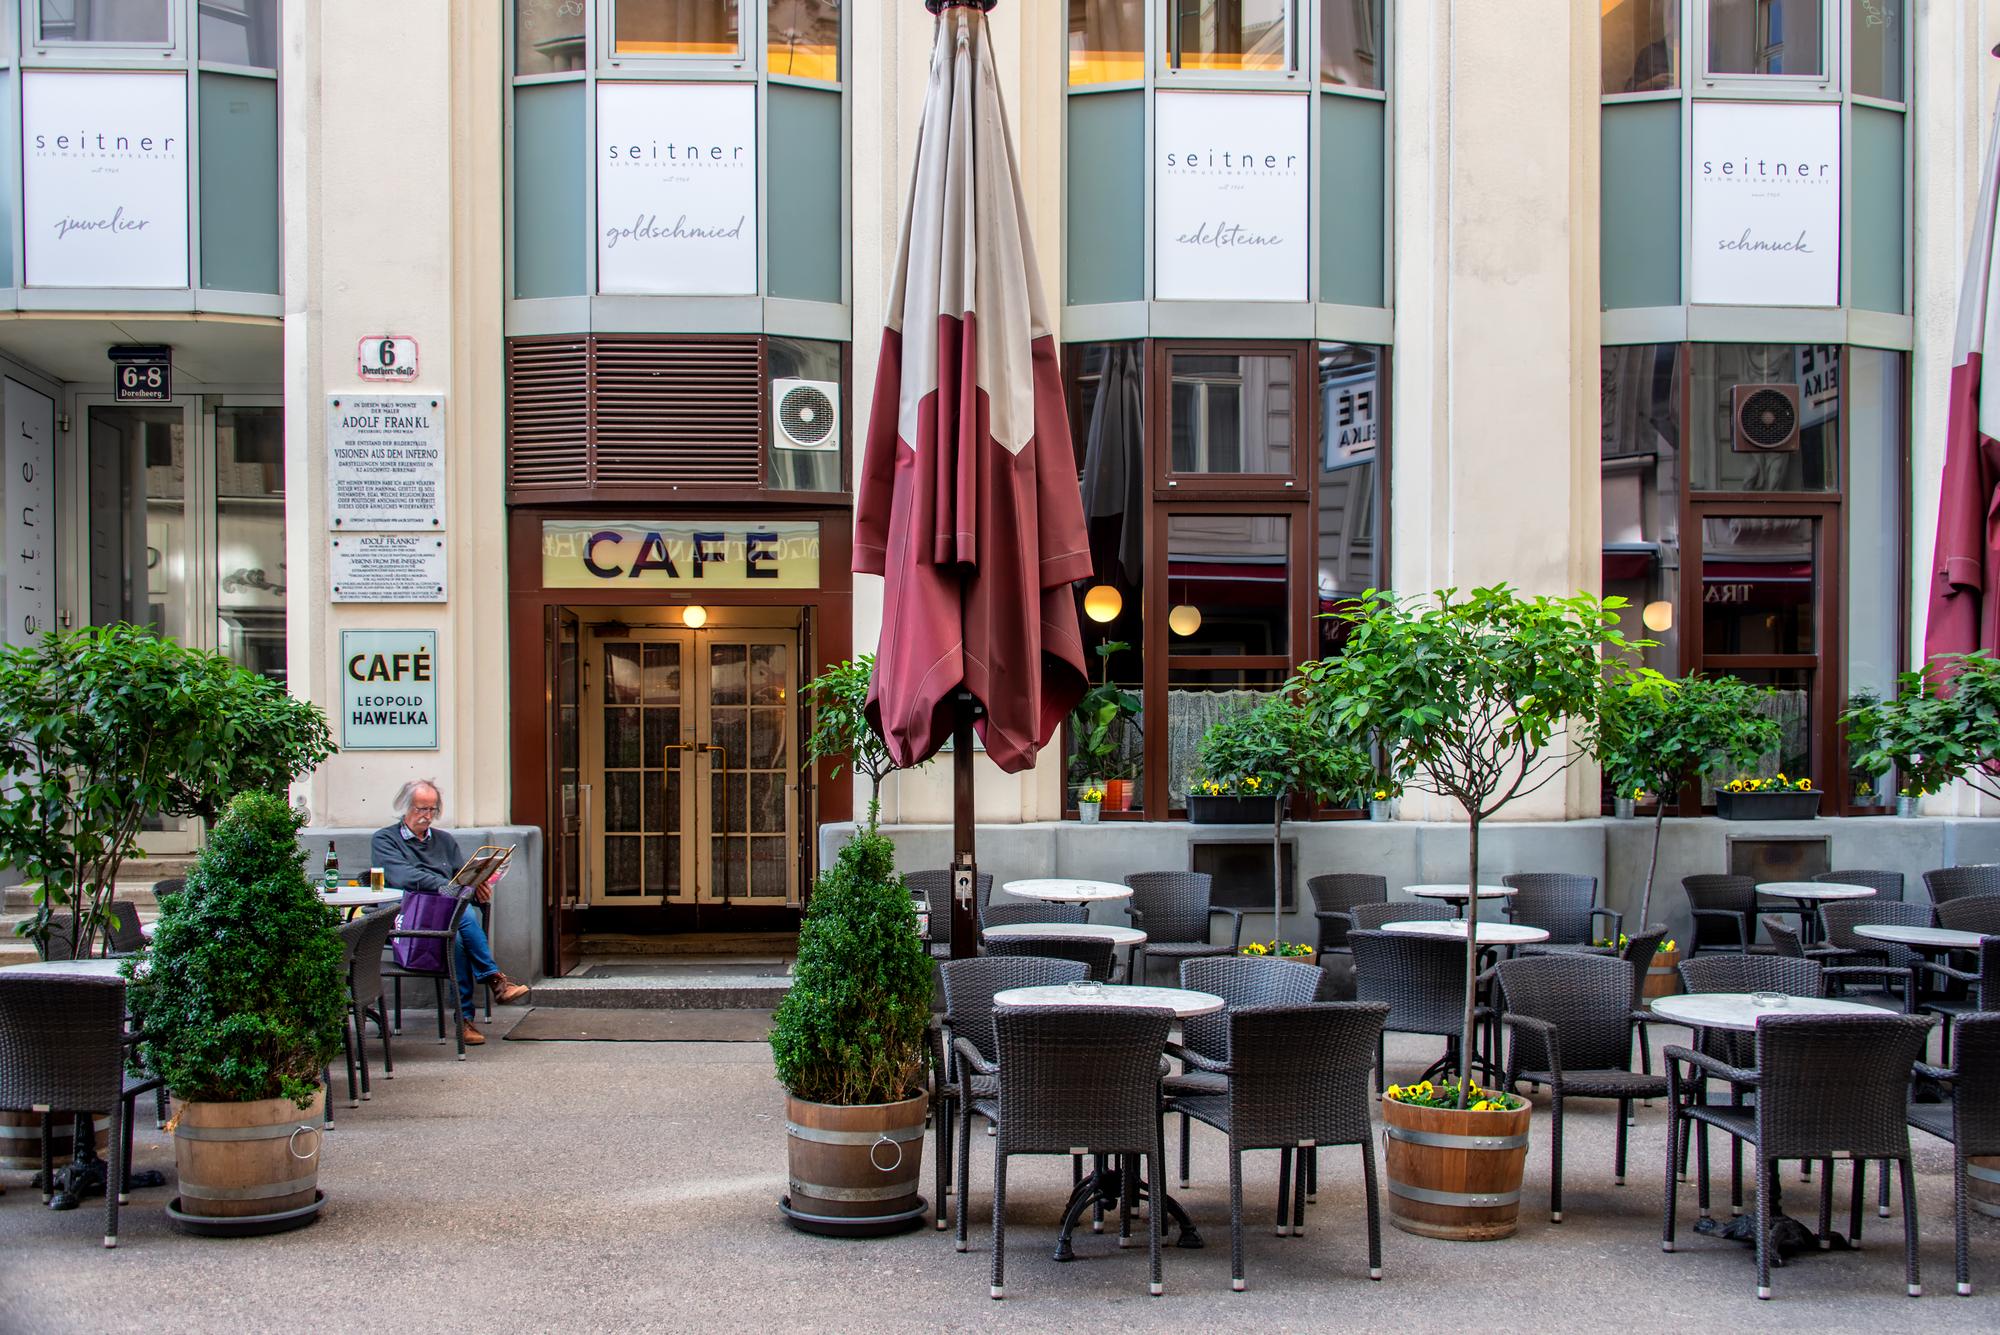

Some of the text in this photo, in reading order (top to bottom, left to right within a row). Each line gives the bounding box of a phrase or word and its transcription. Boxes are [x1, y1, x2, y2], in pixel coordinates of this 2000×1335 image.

[36, 130, 175, 151] seitner
[609, 140, 743, 160] seitner
[1167, 148, 1296, 168] seitner
[1703, 157, 1829, 177] seitner
[54, 206, 149, 240] juwelier
[606, 213, 745, 249] goldschmied
[1176, 221, 1283, 248] edelsteine
[1718, 227, 1815, 254] schmuck
[379, 340, 395, 366] 6
[123, 366, 162, 388] 6-8
[342, 416, 430, 428] ADOLF FRANKL
[334, 448, 438, 459] VISIONEN AUS DEM INFERNO
[19, 421, 36, 635] eitner
[583, 525, 778, 579] CAFÉ
[348, 645, 431, 682] CAFÉ
[357, 696, 423, 707] LEOPOLD
[352, 711, 429, 726] HAWELKA
